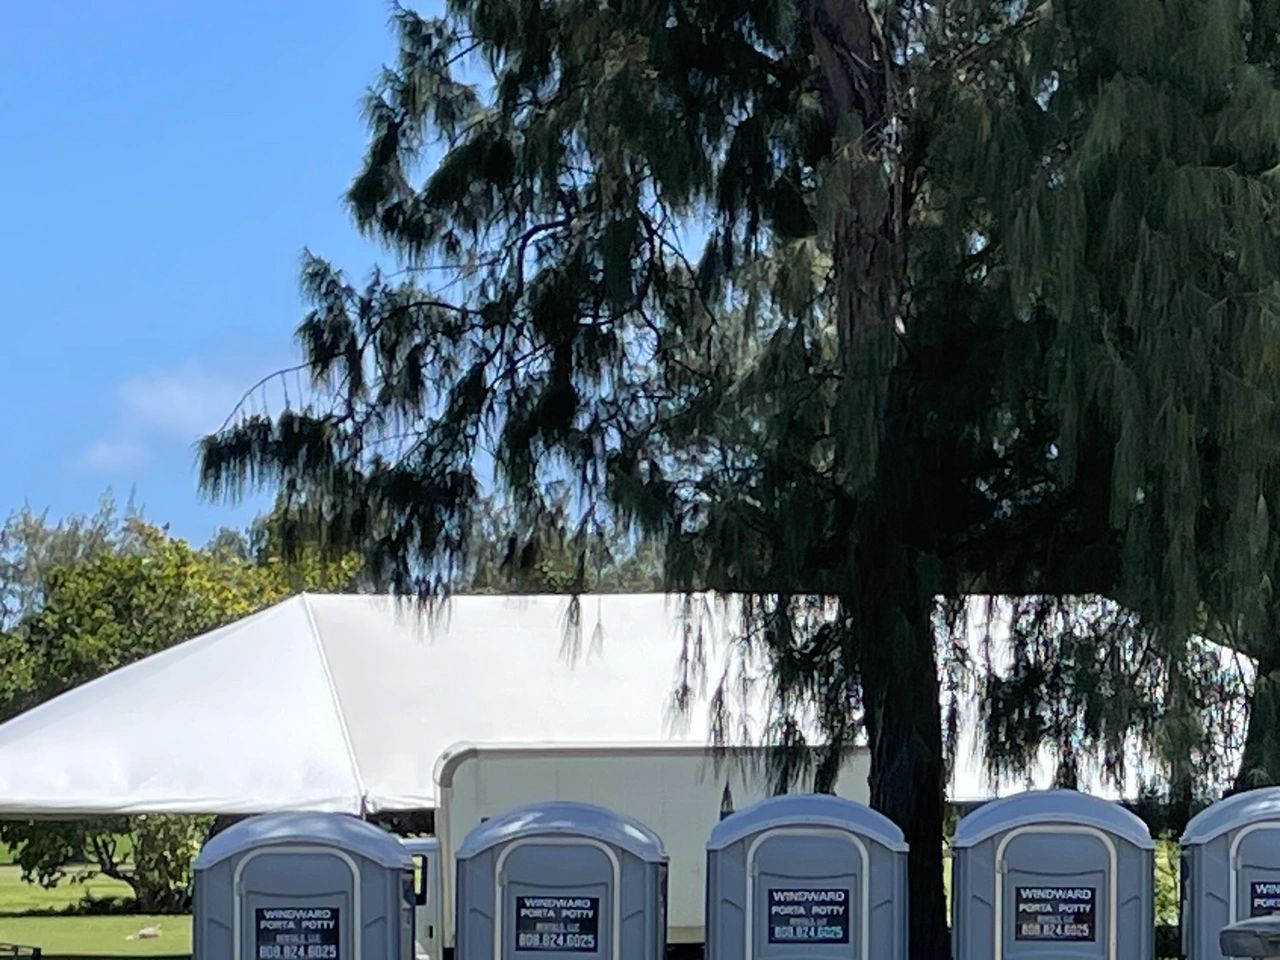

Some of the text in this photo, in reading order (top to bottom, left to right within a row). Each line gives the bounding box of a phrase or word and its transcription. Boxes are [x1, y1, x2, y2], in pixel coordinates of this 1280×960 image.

[773, 891, 845, 902] WINDWARD
[1020, 889, 1091, 900] WINDWARD
[524, 898, 590, 908] WINDWARD
[1018, 903, 1091, 913] PORTA POTTY
[264, 910, 331, 918] WINDWARD
[520, 909, 594, 919] PORTA POTTY
[771, 906, 844, 915] PORTA POTTY
[260, 920, 335, 929] PORTA POTTY
